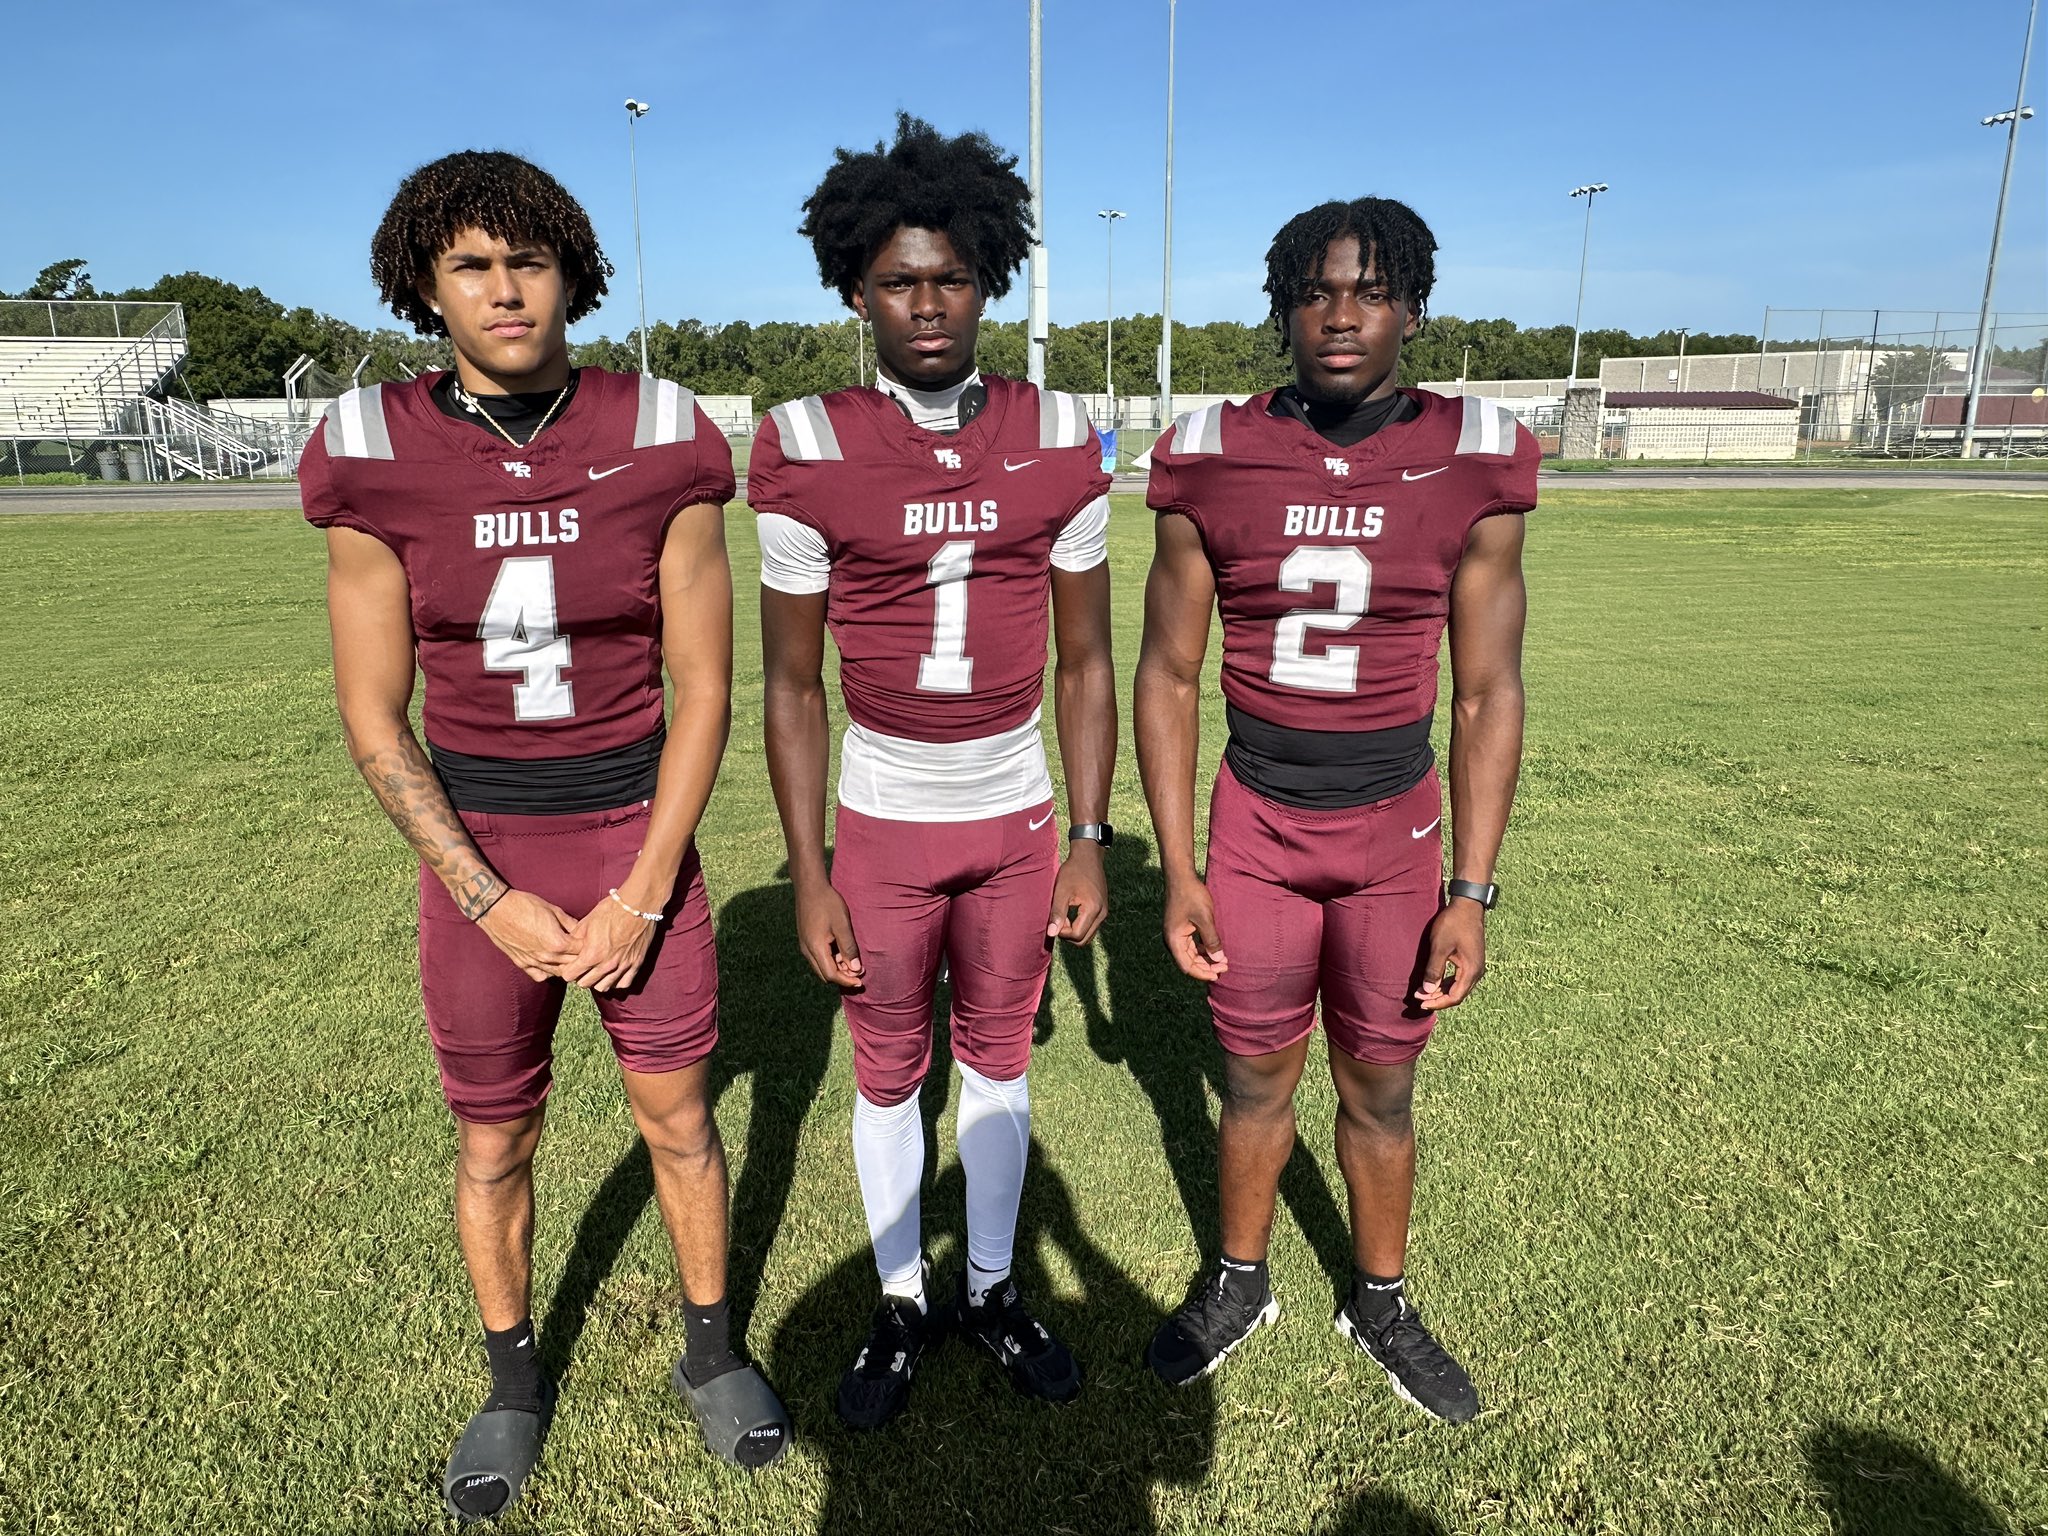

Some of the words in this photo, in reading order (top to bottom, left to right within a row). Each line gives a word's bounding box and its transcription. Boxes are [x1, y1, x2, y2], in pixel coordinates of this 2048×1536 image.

[473, 508, 580, 549] BULLS
[903, 500, 998, 536] BULLS
[1283, 505, 1385, 538] BULLS
[916, 540, 976, 693] 1
[1269, 545, 1373, 692] 2
[476, 555, 576, 721] 4
[749, 1428, 780, 1438] DRI-FIT
